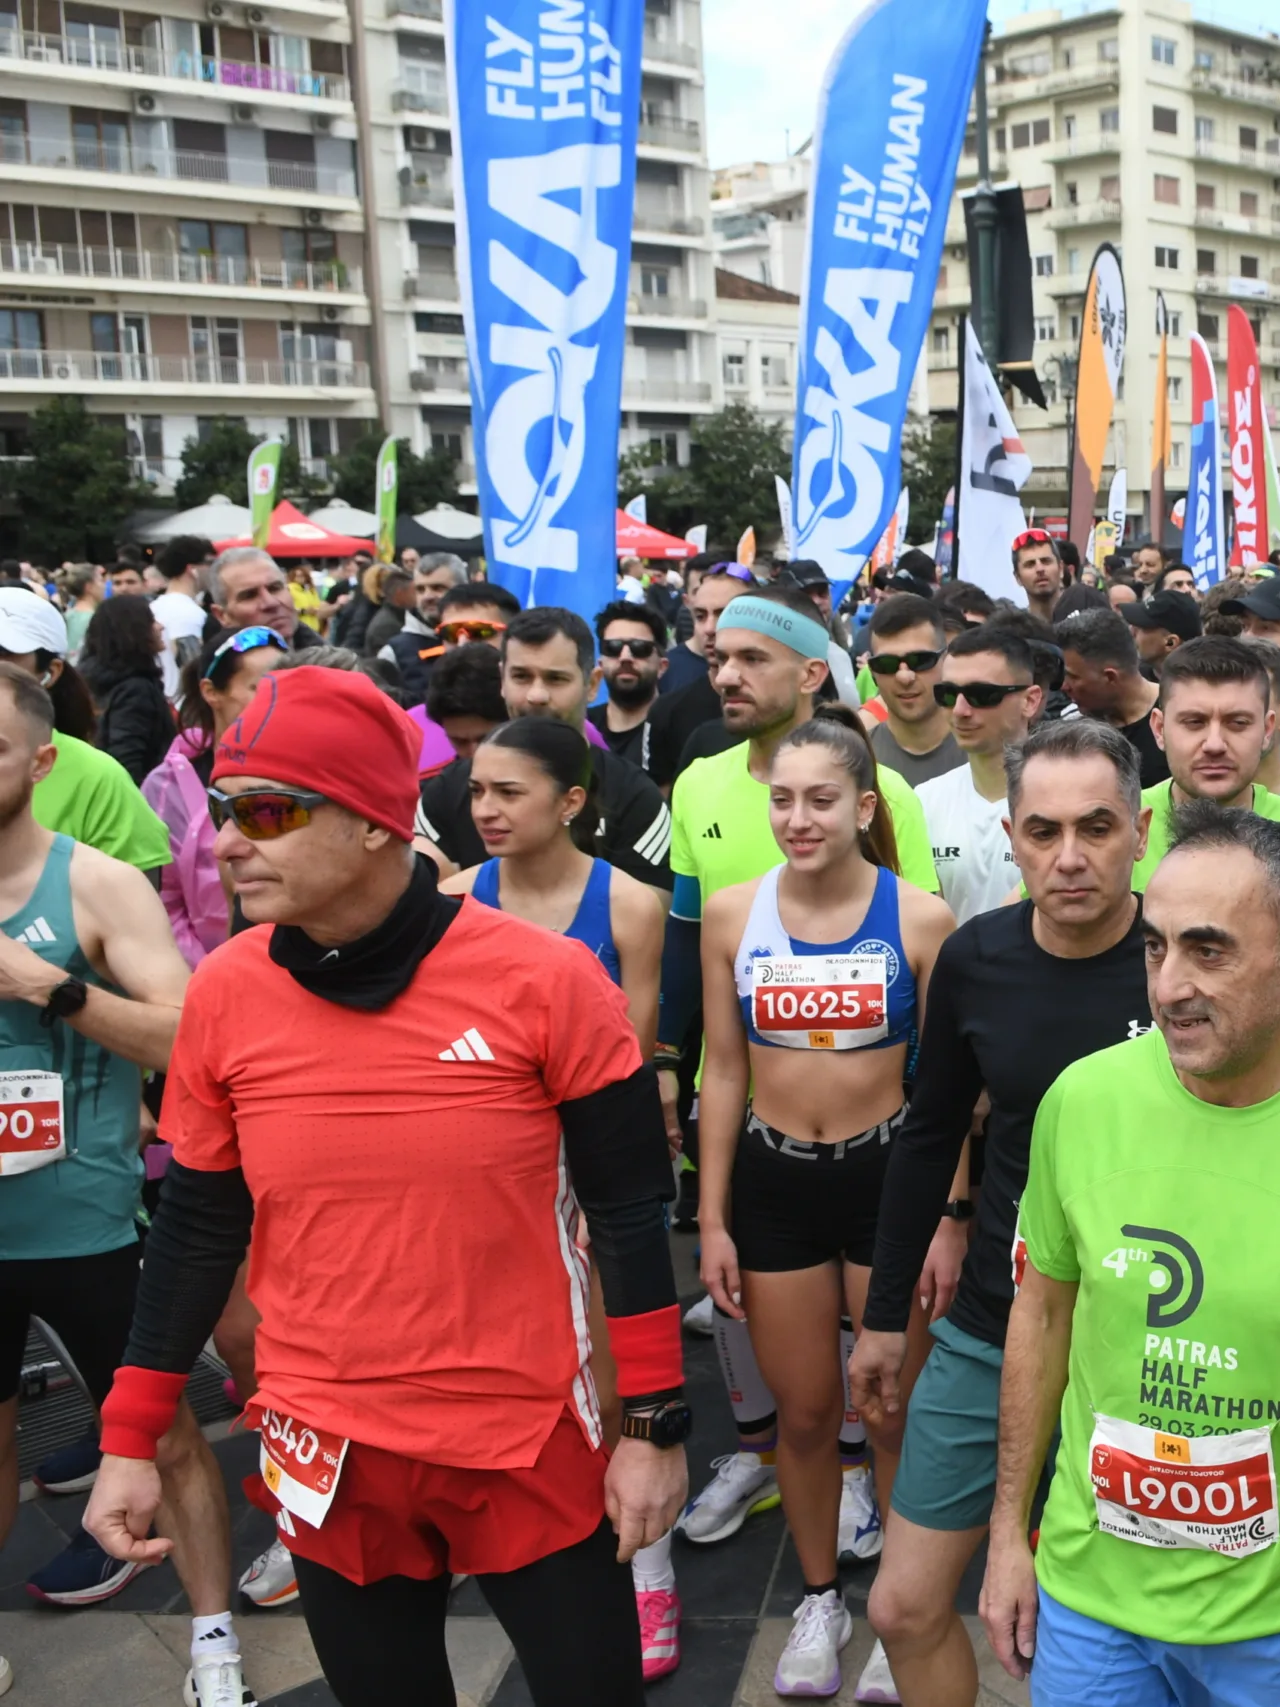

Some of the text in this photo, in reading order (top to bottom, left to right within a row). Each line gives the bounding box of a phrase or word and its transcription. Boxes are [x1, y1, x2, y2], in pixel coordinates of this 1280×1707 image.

[486, 14, 536, 121] FLY
[588, 19, 622, 127] FLY
[871, 72, 928, 250] HUMAN
[833, 163, 876, 243] FLY
[899, 180, 932, 260] FLY
[761, 990, 883, 1020] 10625 10K
[1102, 1247, 1148, 1279] 4th
[1145, 1333, 1239, 1371] PATRAS
[1141, 1358, 1208, 1390] HALF
[1138, 1413, 1253, 1437] 29.03.20
[322, 1452, 338, 1468] 10K
[1123, 1471, 1258, 1517] 10061
[1187, 1523, 1246, 1535] MARATHON
[1219, 1533, 1247, 1544] HALF
[1208, 1539, 1248, 1552] PATRAS
